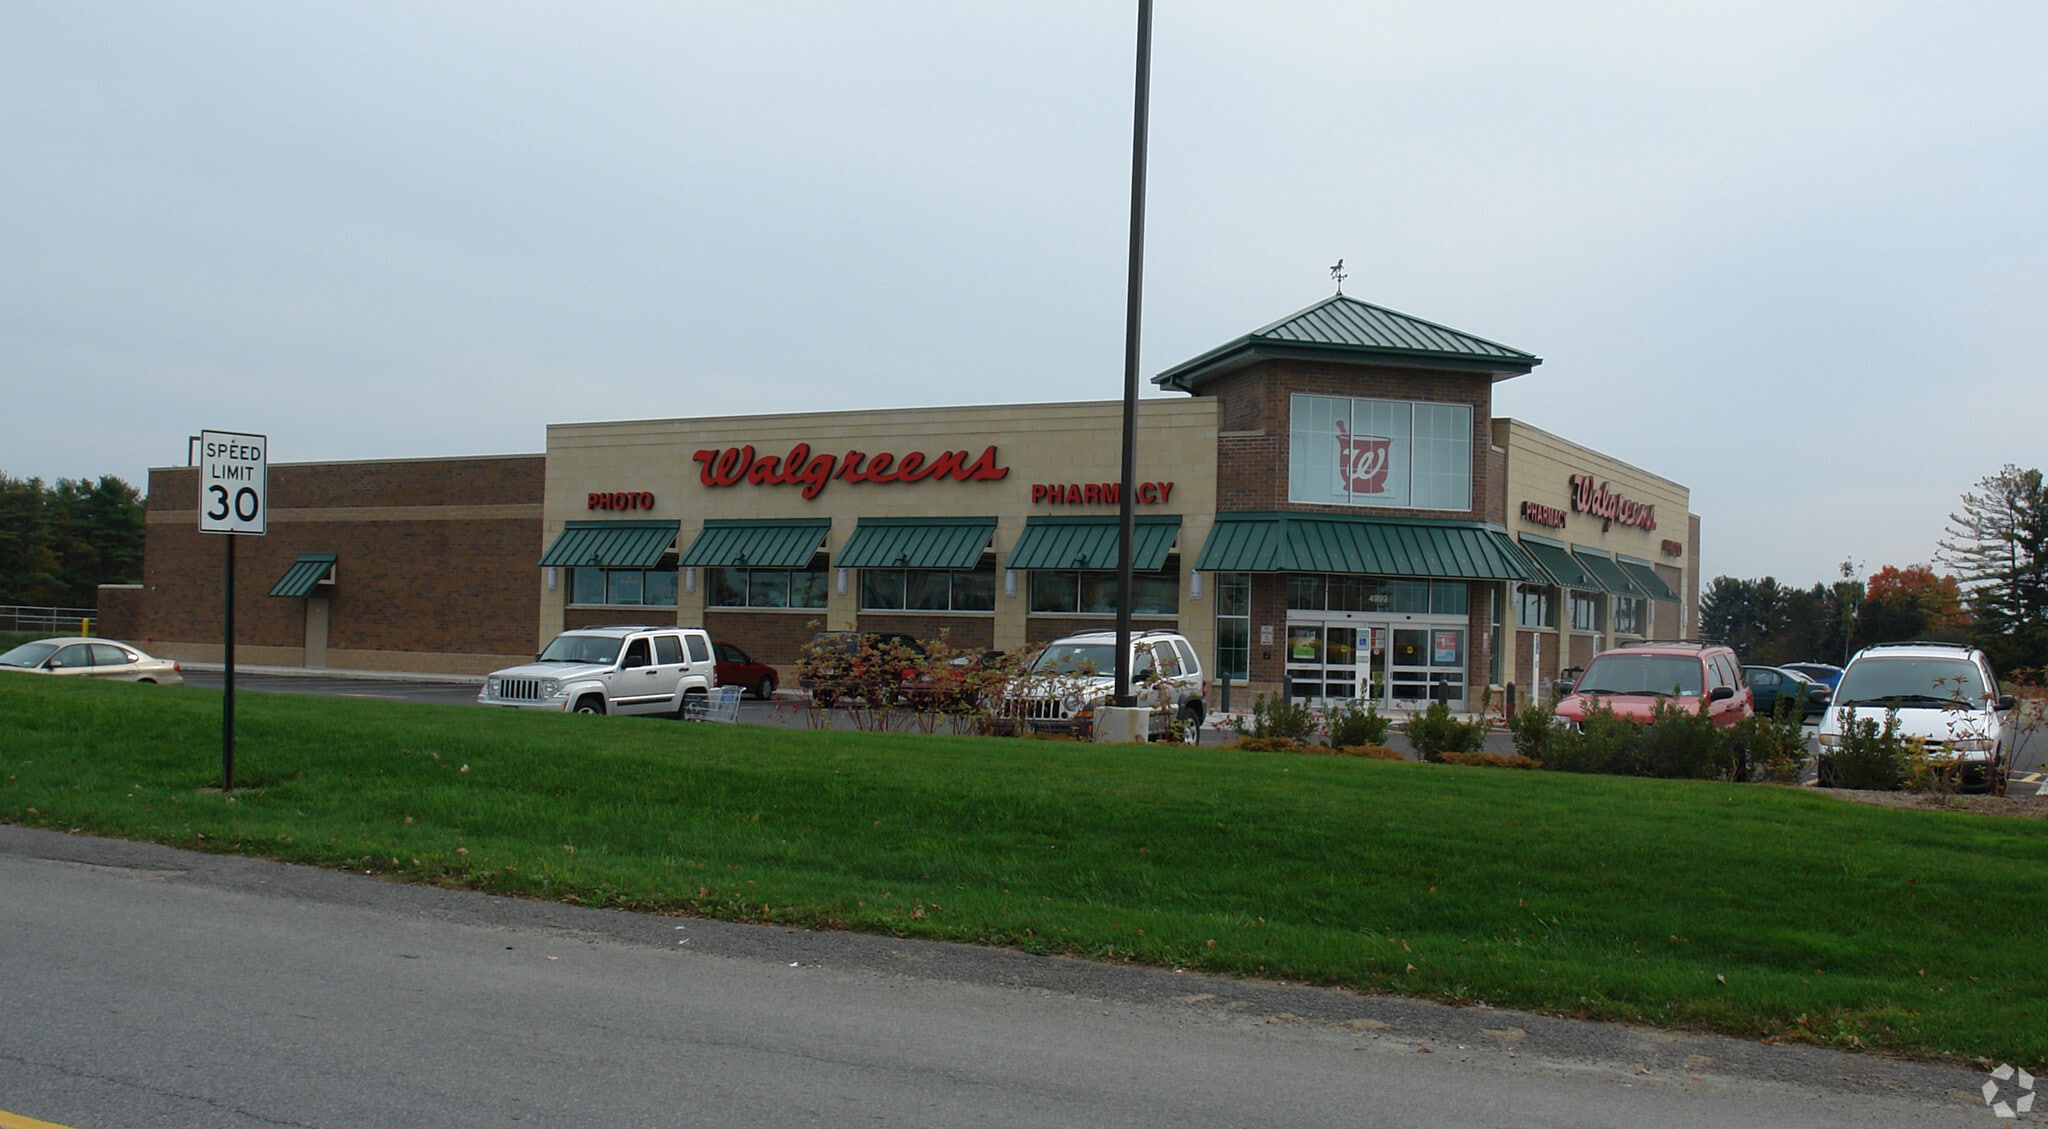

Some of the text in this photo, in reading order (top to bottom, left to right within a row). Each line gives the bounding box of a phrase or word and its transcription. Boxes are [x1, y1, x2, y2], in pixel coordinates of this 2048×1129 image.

[207, 443, 261, 461] SPEED
[212, 464, 254, 481] LIMIT
[692, 442, 1010, 500] Walgreens
[207, 484, 259, 522] 30
[587, 491, 655, 511] PHOTO
[1031, 482, 1174, 504] PHARMCY
[1570, 474, 1657, 533] Walgreens
